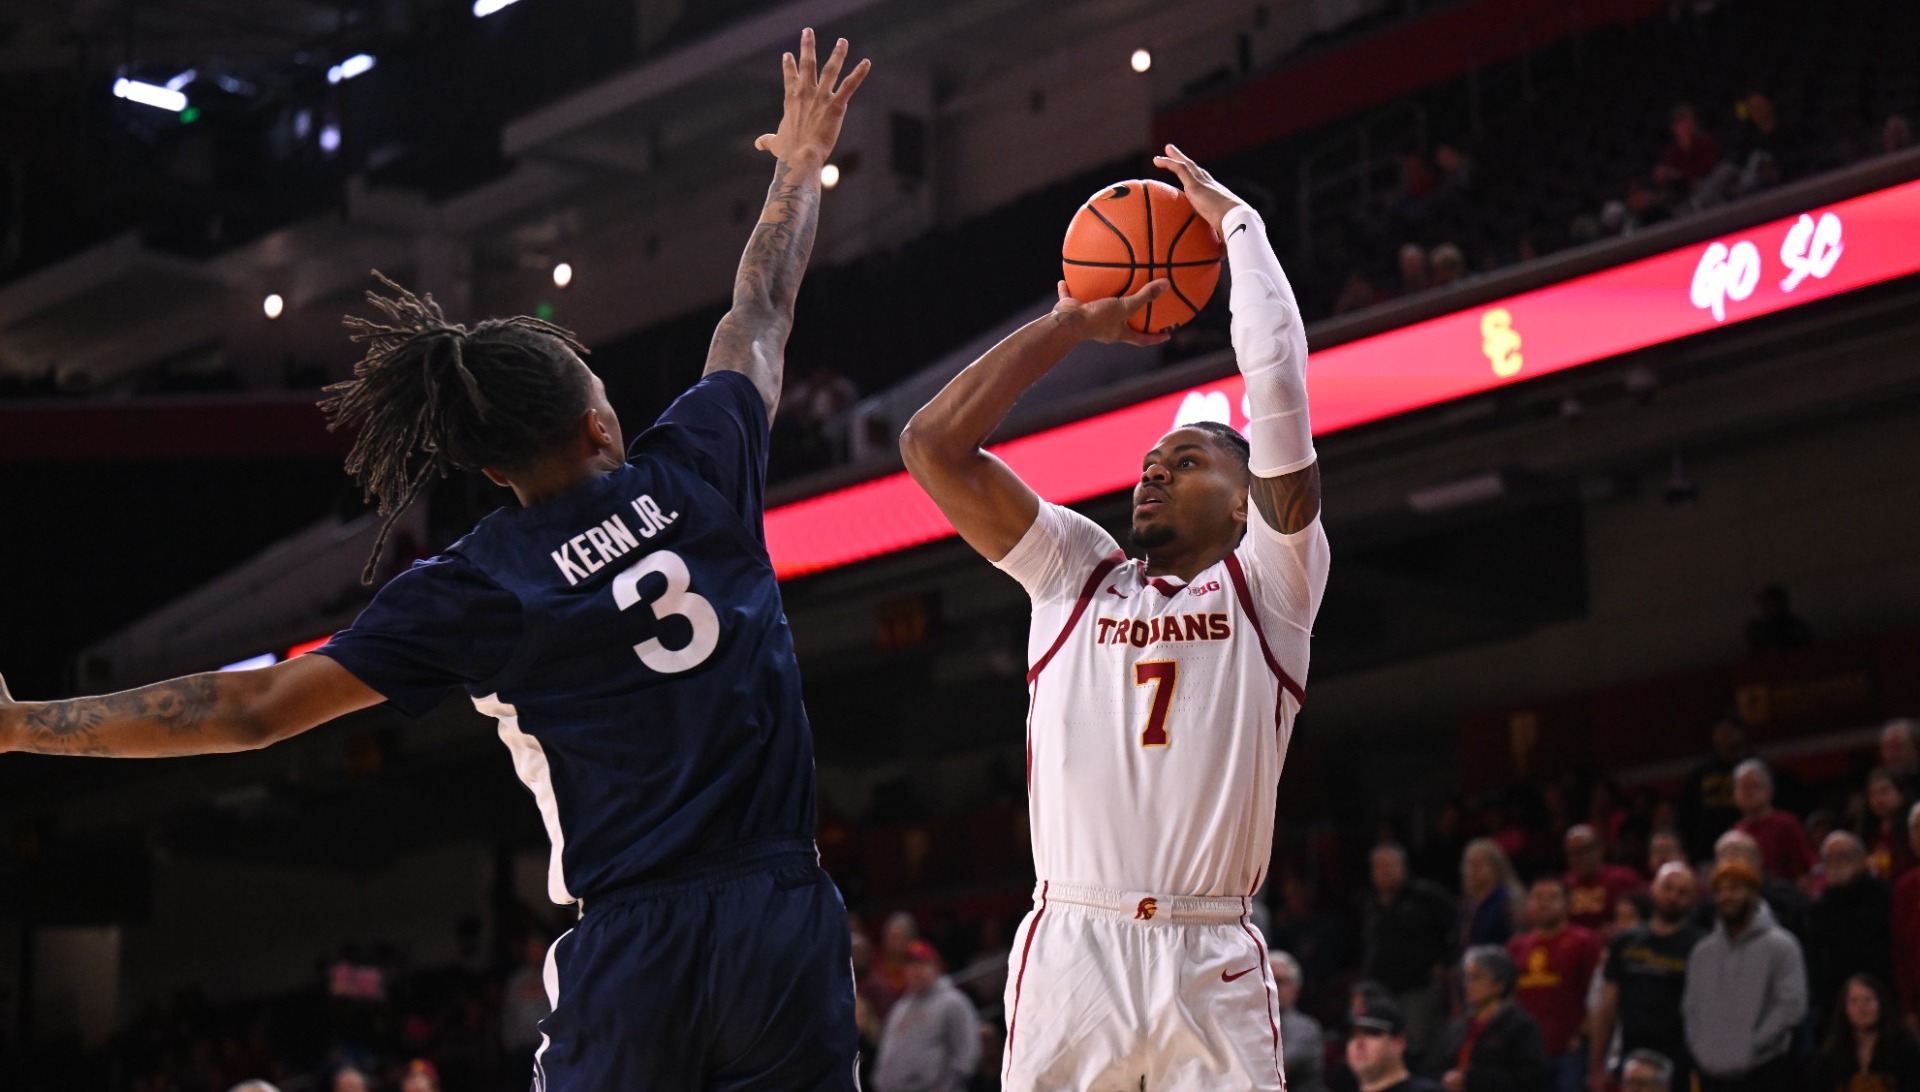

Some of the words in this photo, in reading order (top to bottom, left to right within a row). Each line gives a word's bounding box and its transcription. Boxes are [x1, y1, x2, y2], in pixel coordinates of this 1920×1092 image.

[1690, 241, 1760, 322] GO
[1780, 212, 1843, 292] SC
[551, 513, 640, 586] KERN
[630, 494, 679, 539] JR.
[612, 550, 720, 674] 3
[1097, 612, 1232, 648] TROJANS
[1134, 659, 1178, 748] 7
